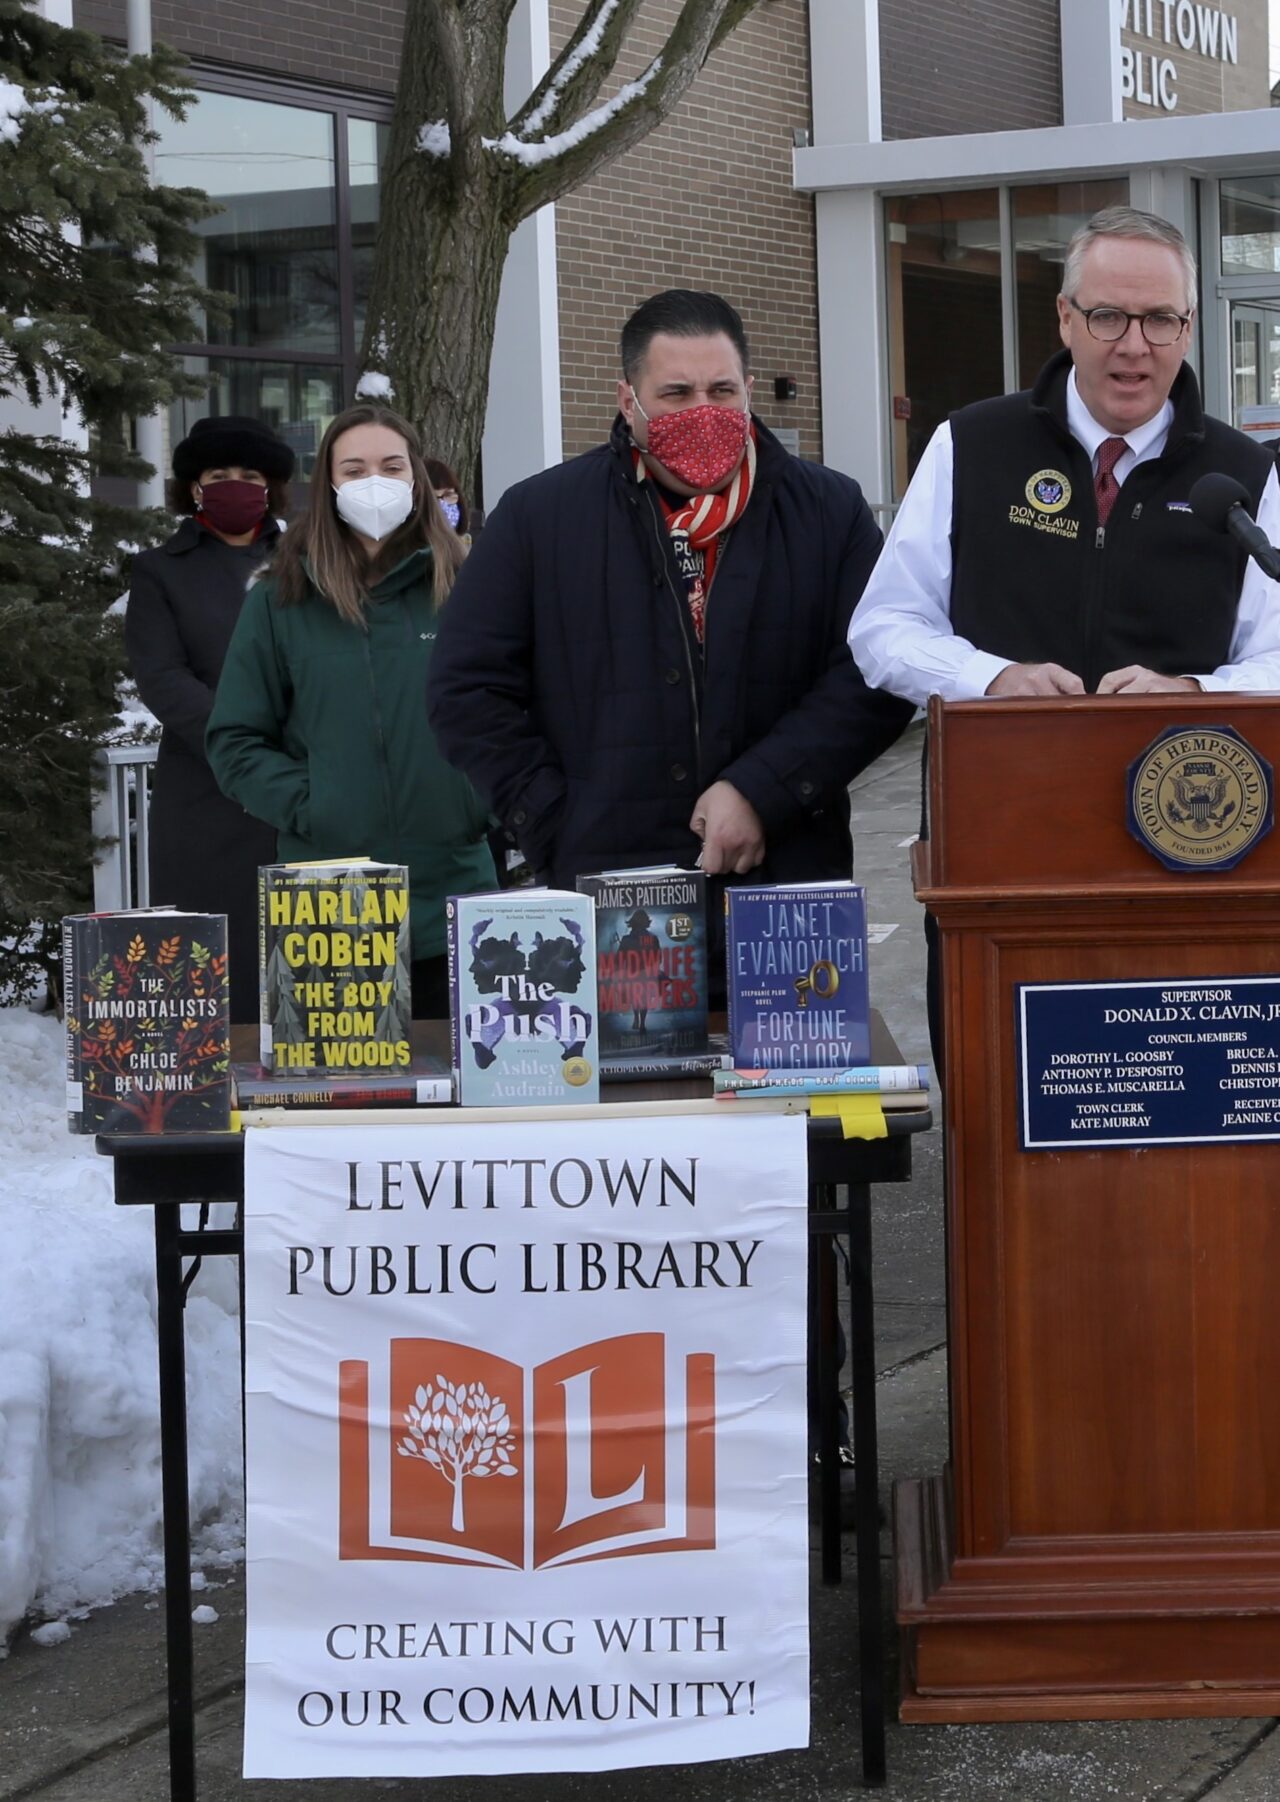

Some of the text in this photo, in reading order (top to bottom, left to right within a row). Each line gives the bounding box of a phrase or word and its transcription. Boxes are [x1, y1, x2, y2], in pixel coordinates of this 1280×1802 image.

[1009, 505, 1080, 532] DON CLAVIN
[1009, 515, 1078, 539] TOWN SUPERVISOR
[1146, 757, 1164, 781] OF
[1140, 786, 1163, 838] TOWN
[1172, 841, 1213, 854] FOUNDED
[269, 889, 409, 926] HARLAN
[596, 884, 698, 909] JAMES PATTERSON
[797, 892, 834, 900] BESTSELLING
[762, 902, 833, 938] JANET
[284, 932, 396, 968] COBEN
[737, 938, 863, 975] EVANOVICH
[64, 934, 74, 1014] IMMORTALISTS
[599, 944, 698, 981] MIDWIFE
[140, 978, 165, 993] THE
[294, 981, 335, 1008] THE
[343, 981, 394, 1008] BOY
[494, 974, 555, 1002] The
[599, 978, 699, 1013] MURDERS
[740, 989, 770, 997] STEPHANIE
[1161, 989, 1233, 1003] SUPERVISOR
[88, 999, 218, 1020] IMMORTALISTS
[1104, 1007, 1178, 1024] DONALD
[1180, 1006, 1196, 1021] X.
[1199, 1005, 1265, 1021] CLAVIN,
[308, 1011, 375, 1038] FROM
[468, 1002, 588, 1042] Push
[757, 1010, 847, 1042] FORTUNE
[1148, 1032, 1248, 1044] COUNCIL MEMBERS
[129, 1052, 178, 1069] CHLOE
[273, 1040, 411, 1068] THE WOODS
[753, 1042, 853, 1069] AND GLORY
[1051, 1050, 1175, 1065] DOROTHY L. GOOSBY
[1226, 1048, 1266, 1060] BRUCE
[1266, 1047, 1279, 1058] A.
[499, 1059, 560, 1078] Ashley
[1041, 1065, 1184, 1080] ANTHONY P. D'ESPOSITO
[1231, 1062, 1276, 1075] DENNIS
[114, 1075, 193, 1093] BENJAMIN
[491, 1081, 565, 1097] Audrain
[724, 1079, 744, 1088] THE
[1040, 1080, 1185, 1095] THOMAS E. MUSCARELLA
[254, 1090, 335, 1105] MICHAEL CONNELLY
[1076, 1103, 1145, 1114] TOWN CLERK
[1070, 1116, 1152, 1129] KATE MURRAY
[1222, 1113, 1272, 1127] JEANINE
[344, 1156, 698, 1212] LEVITTOWN
[285, 1239, 764, 1297] PUBLIC LIBRARY
[553, 1366, 645, 1534] L
[325, 1616, 729, 1661] CREATING WITH
[297, 1680, 757, 1728] OUR COMMUNITY!
